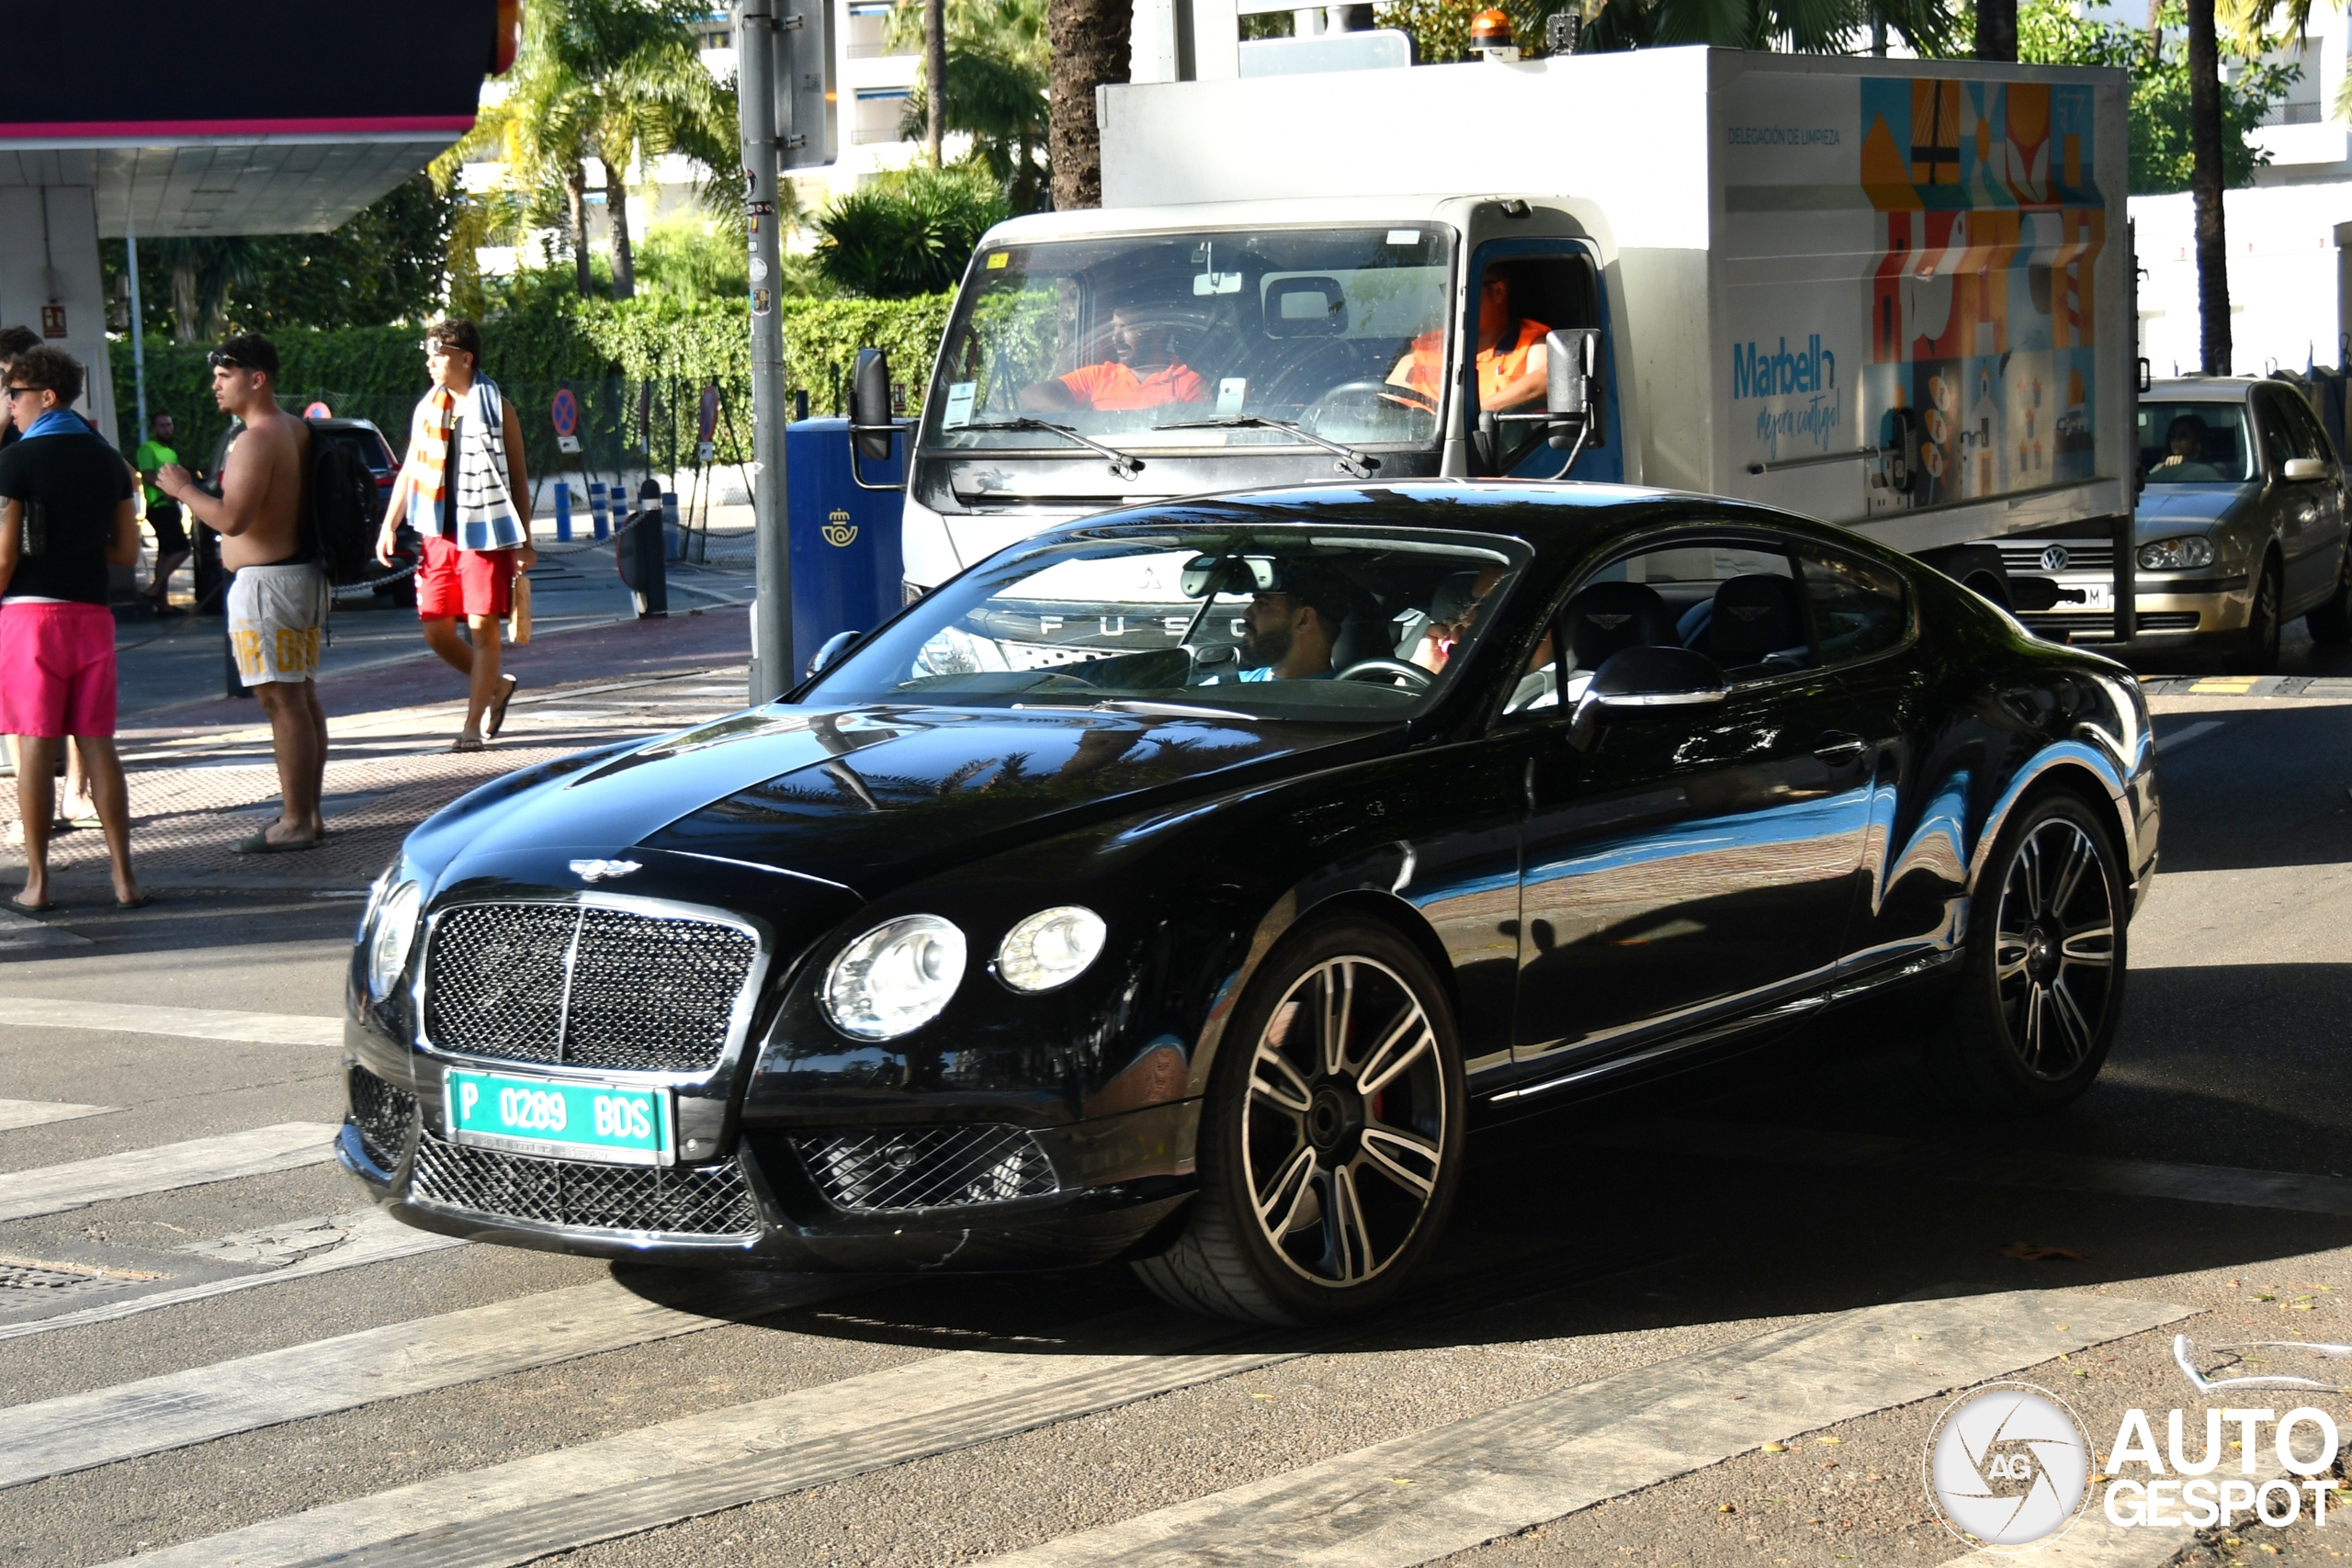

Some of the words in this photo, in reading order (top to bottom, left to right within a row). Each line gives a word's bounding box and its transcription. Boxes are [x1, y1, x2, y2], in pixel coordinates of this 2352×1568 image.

[1728, 125, 1785, 145] DELEGACIÓN
[1788, 129, 1800, 145] DE
[1802, 130, 1840, 146] LIMPIEZA
[461, 1081, 480, 1120] P
[500, 1087, 568, 1131] 0289
[593, 1095, 651, 1139] BDS
